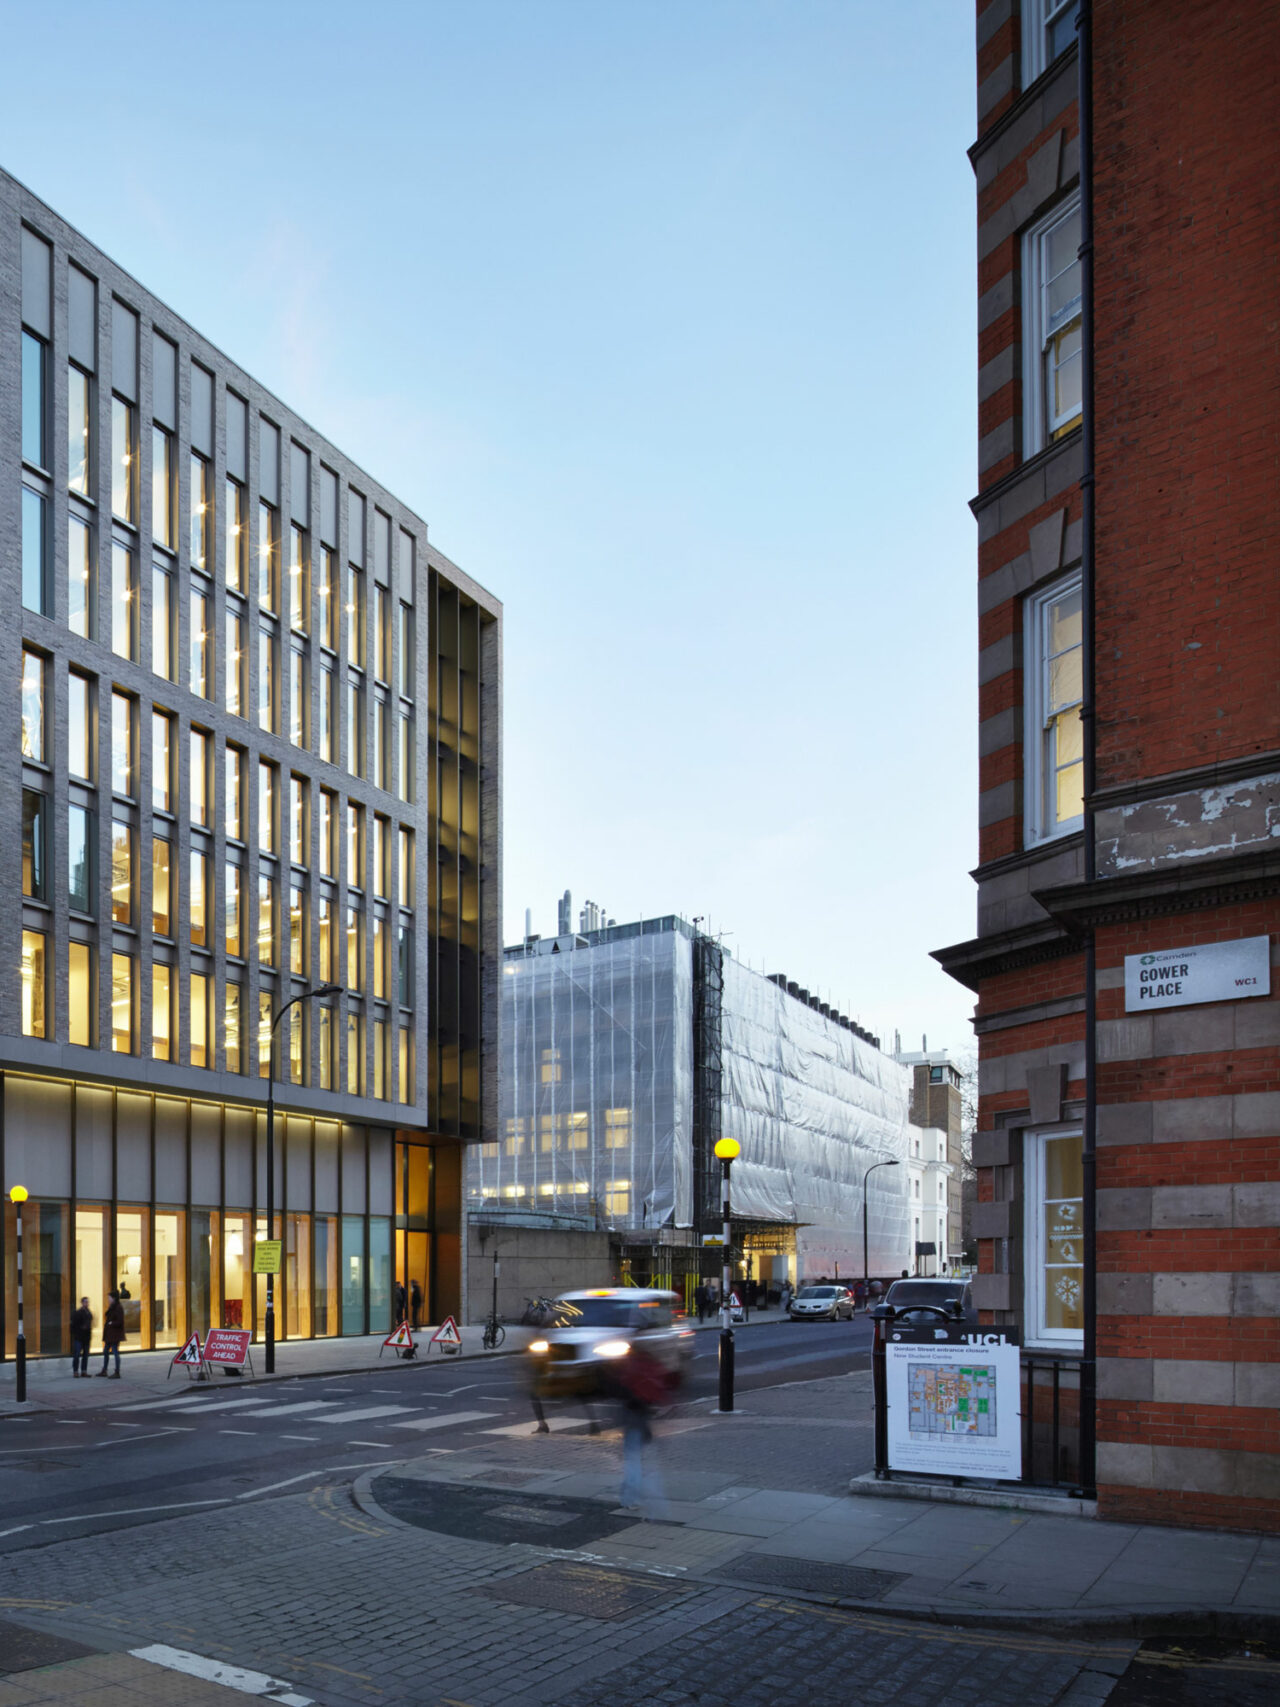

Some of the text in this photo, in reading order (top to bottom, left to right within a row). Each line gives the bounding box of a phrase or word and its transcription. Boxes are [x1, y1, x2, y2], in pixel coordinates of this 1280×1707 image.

[1156, 952, 1197, 962] Camden
[1140, 964, 1189, 982] GOWER
[1235, 977, 1257, 987] WC1
[1140, 982, 1182, 999] PLACE
[216, 1333, 242, 1342] TRAFFIC
[967, 1334, 1013, 1346] UCL
[211, 1342, 242, 1351] CONTROL
[213, 1351, 236, 1359] AHEAD
